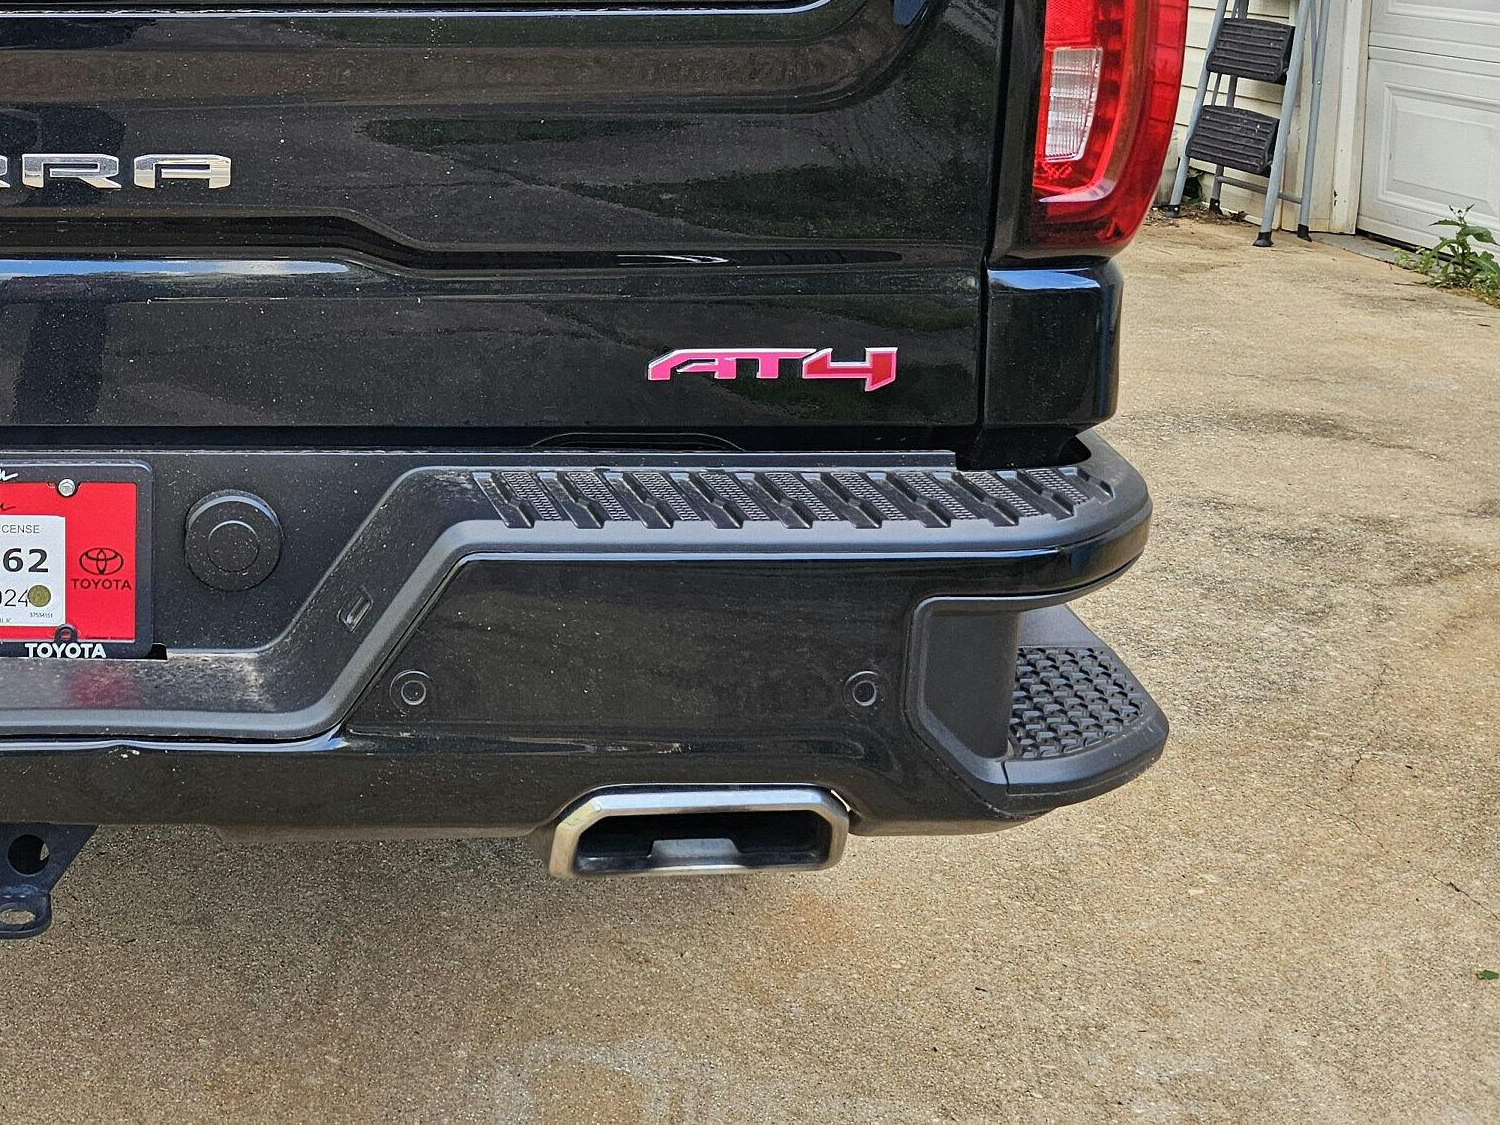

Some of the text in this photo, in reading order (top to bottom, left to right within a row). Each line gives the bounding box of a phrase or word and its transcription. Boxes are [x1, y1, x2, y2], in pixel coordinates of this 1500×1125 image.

[647, 347, 898, 392] AT4
[70, 578, 132, 591] TOYOTA
[25, 642, 107, 659] TOYOTA
